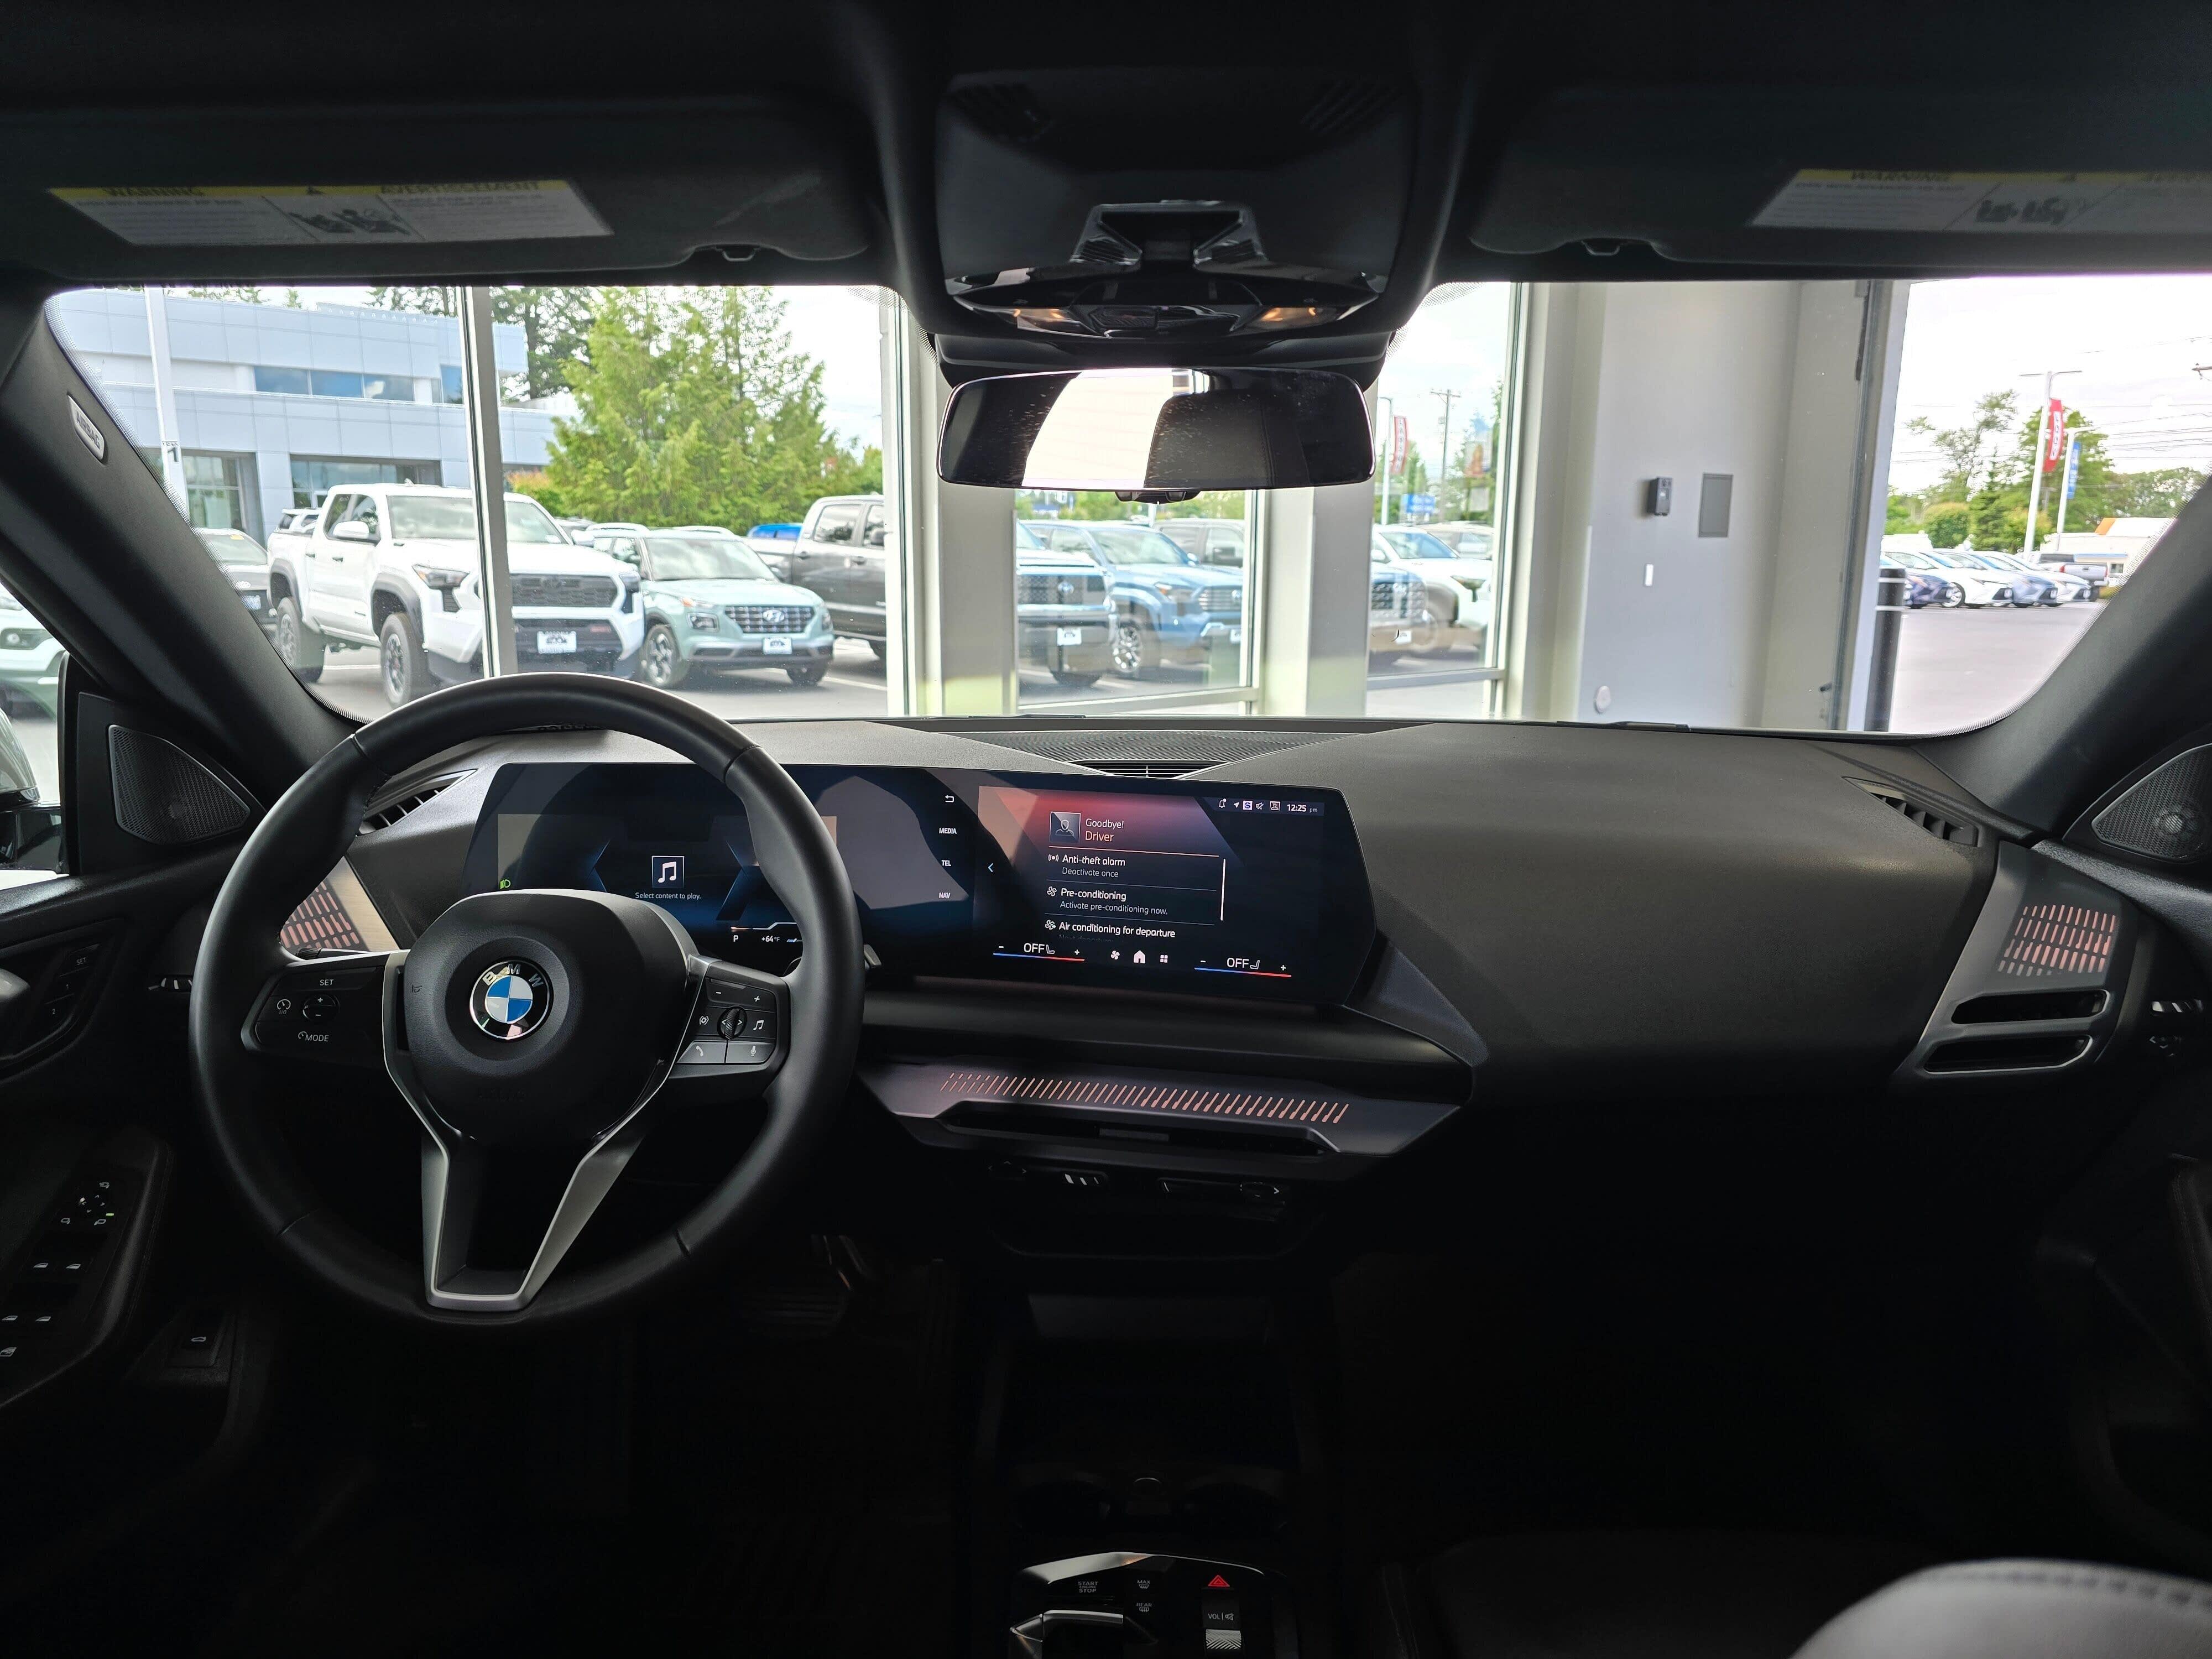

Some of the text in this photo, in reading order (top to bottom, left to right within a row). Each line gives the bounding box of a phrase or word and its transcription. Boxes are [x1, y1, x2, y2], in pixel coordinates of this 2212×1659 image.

[1287, 804, 1307, 812] 12:25
[1086, 818, 1124, 830] Goodbye!
[1085, 831, 1114, 842] Driver
[1062, 854, 1126, 867] Anti-theft alarm
[1062, 867, 1099, 877] Deactivate
[1061, 888, 1126, 902] Pre-conditioning
[1060, 900, 1089, 910] Activate
[1090, 904, 1149, 915] pre-conditioning
[1058, 921, 1176, 937] Air conditioning for departure
[1023, 942, 1045, 953] OFF
[1227, 957, 1250, 968] OFF
[482, 963, 544, 988] BMW
